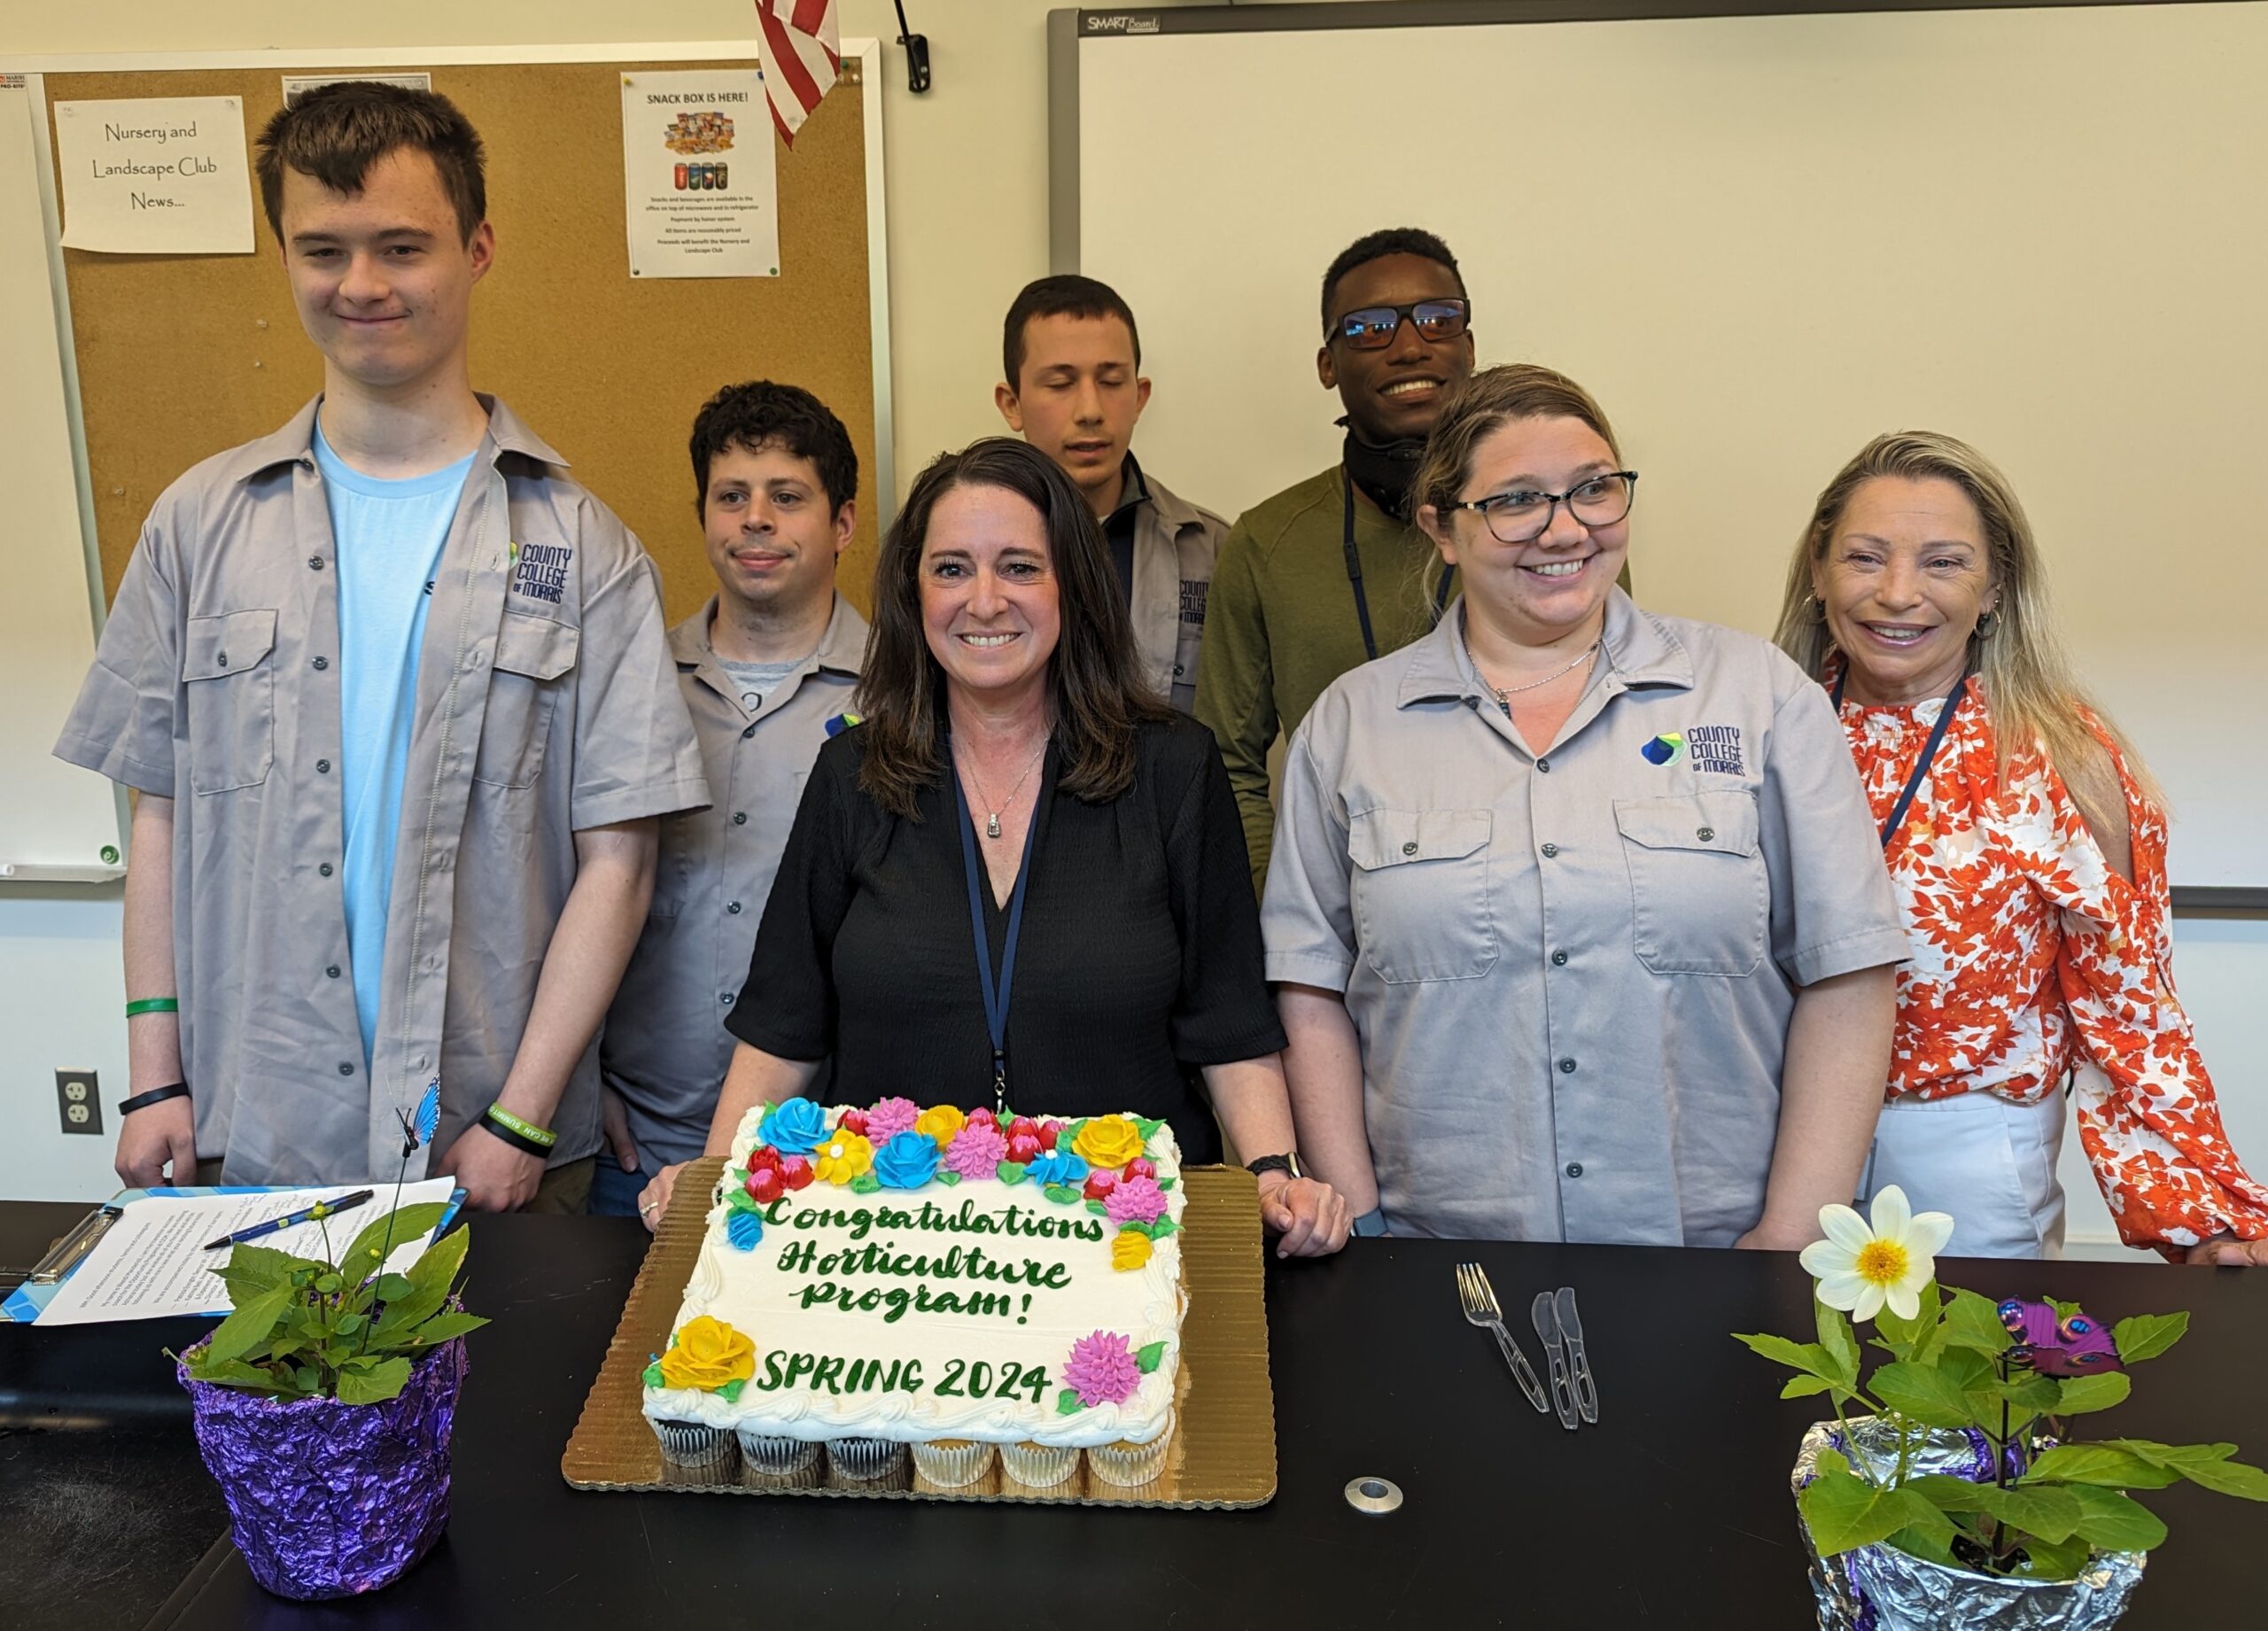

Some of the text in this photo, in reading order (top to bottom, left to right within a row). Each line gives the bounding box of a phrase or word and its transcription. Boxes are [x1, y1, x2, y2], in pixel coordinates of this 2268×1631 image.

[1088, 17, 1129, 30] SMART
[647, 92, 749, 105] SNACK BOX IS HERE!
[105, 121, 197, 144] Nursery and
[92, 157, 217, 181] Landscape Club
[131, 192, 185, 210] News...
[522, 544, 572, 569] COUNTY
[517, 563, 568, 588] COLLEGE
[523, 582, 563, 603] MORRIS
[1179, 595, 1206, 613] COLLEG
[1688, 726, 1740, 746] COUNTY
[1690, 743, 1744, 764] COLLEGE
[1703, 759, 1746, 777] MORRIS
[765, 1198, 1104, 1242] Congratulations
[777, 1239, 1073, 1289] Horticulture
[756, 1349, 1052, 1403] SPRING 2024
